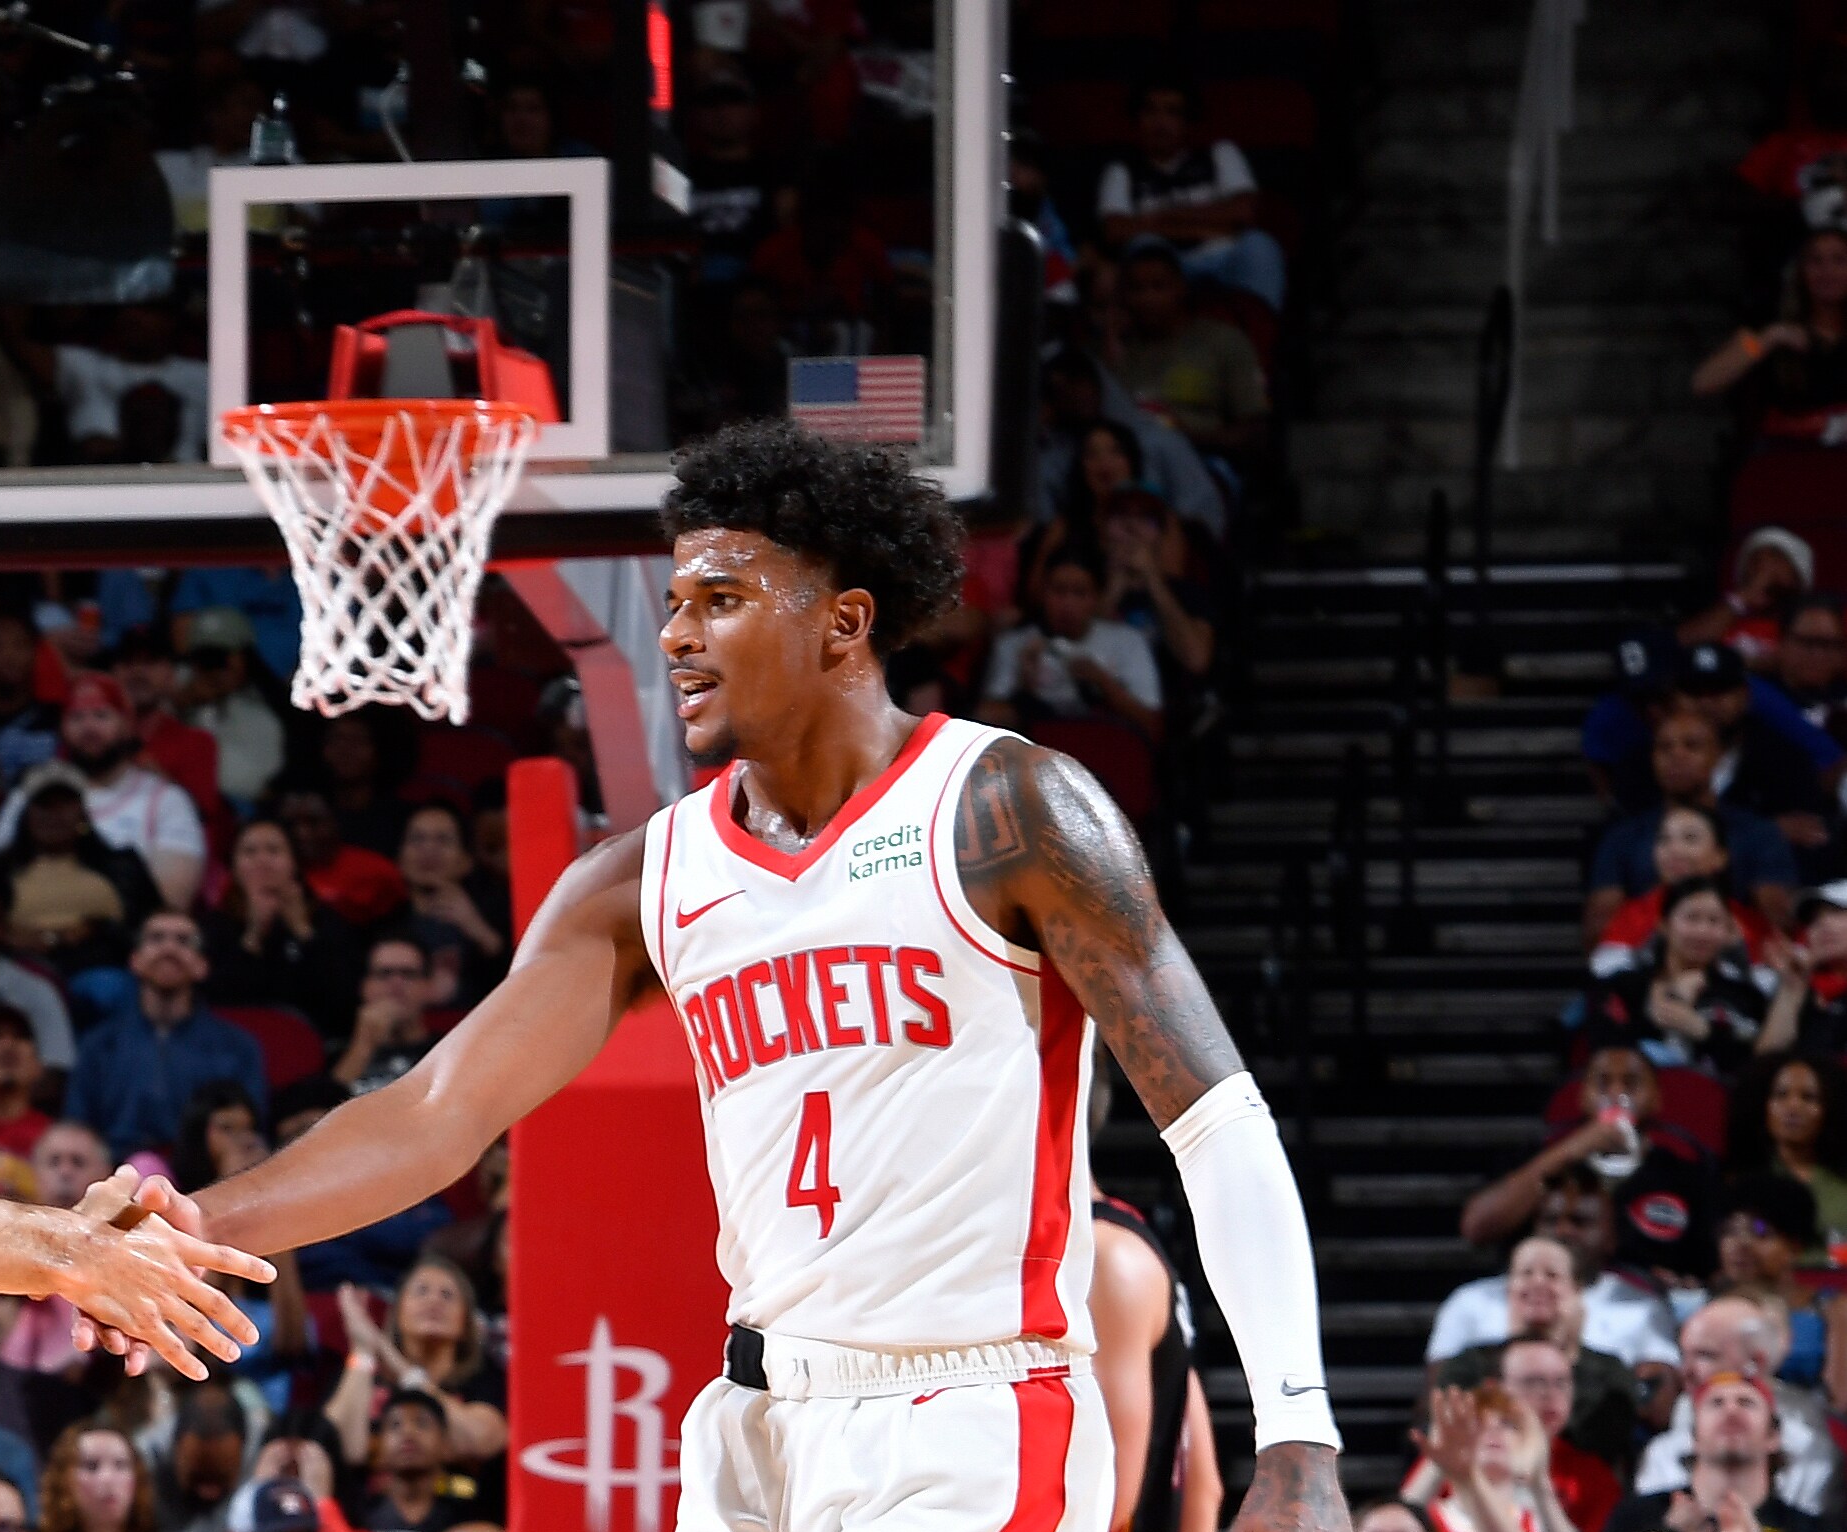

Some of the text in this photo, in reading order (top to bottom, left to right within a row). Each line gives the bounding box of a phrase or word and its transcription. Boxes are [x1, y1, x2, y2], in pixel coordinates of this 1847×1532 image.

[848, 851, 923, 883] karma
[852, 824, 922, 857] credit
[683, 944, 954, 1103] ROCKETS
[785, 1090, 842, 1240] 4
